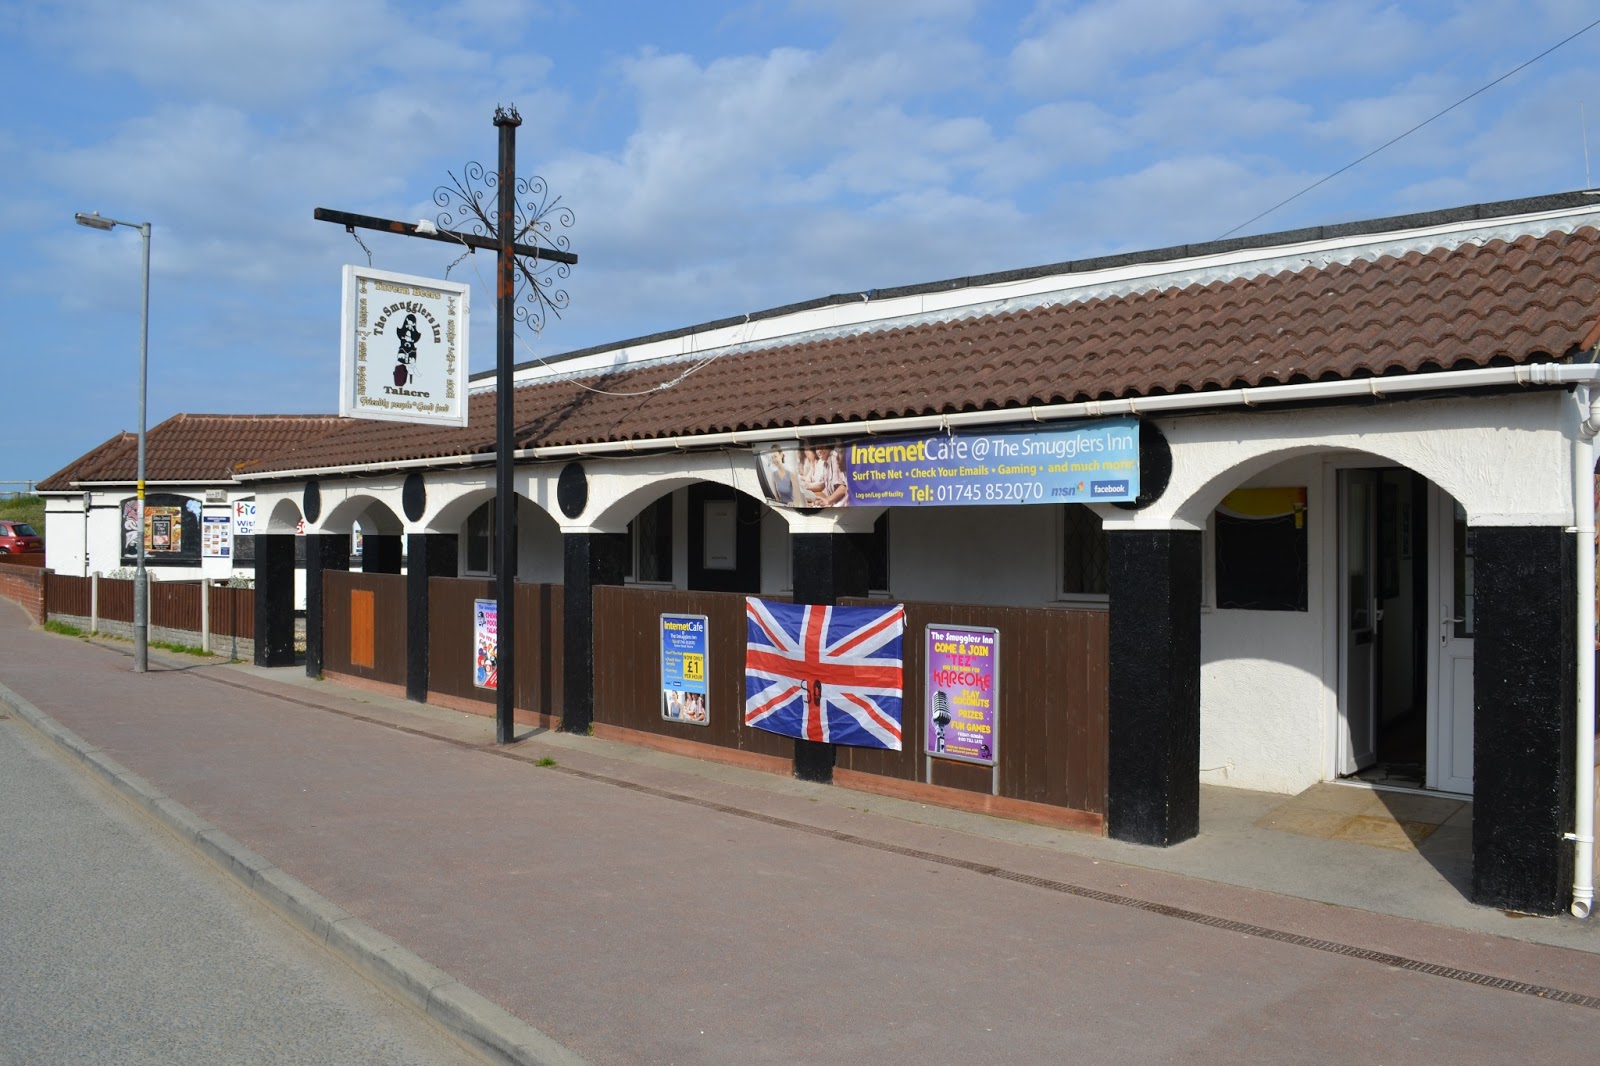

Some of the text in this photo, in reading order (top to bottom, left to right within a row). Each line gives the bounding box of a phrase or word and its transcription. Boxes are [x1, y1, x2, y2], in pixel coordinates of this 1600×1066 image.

[374, 280, 442, 300] Tavern Beers
[373, 300, 442, 344] The Smugglers Inn
[383, 386, 430, 398] Talacre
[359, 396, 390, 409] Friendly
[416, 402, 434, 412] Good
[434, 404, 450, 413] food
[971, 437, 990, 461] @
[992, 439, 1019, 457] The
[1021, 434, 1104, 459] Smugglers
[1107, 433, 1133, 451] Inn
[853, 470, 869, 481] Surf
[870, 470, 887, 480] The
[887, 470, 903, 479] Net
[911, 467, 936, 478] Check
[938, 466, 957, 477] Your
[960, 465, 989, 477] Emails
[998, 464, 1037, 477] Gaming
[1048, 460, 1068, 473] and
[1070, 460, 1100, 472] much
[909, 482, 1043, 502] Tel: 01745 852070
[1051, 487, 1076, 497] msn
[1094, 484, 1125, 494] facebook
[664, 620, 704, 632] InternetCafe
[931, 631, 994, 644] The Smugglers Inn
[934, 642, 989, 656] COME & JOIN
[687, 660, 699, 674] £1
[933, 669, 991, 691] KAREOKE
[962, 689, 980, 699] PLAY
[958, 709, 984, 720] PRIZES
[951, 720, 991, 734] FUN GAMES
